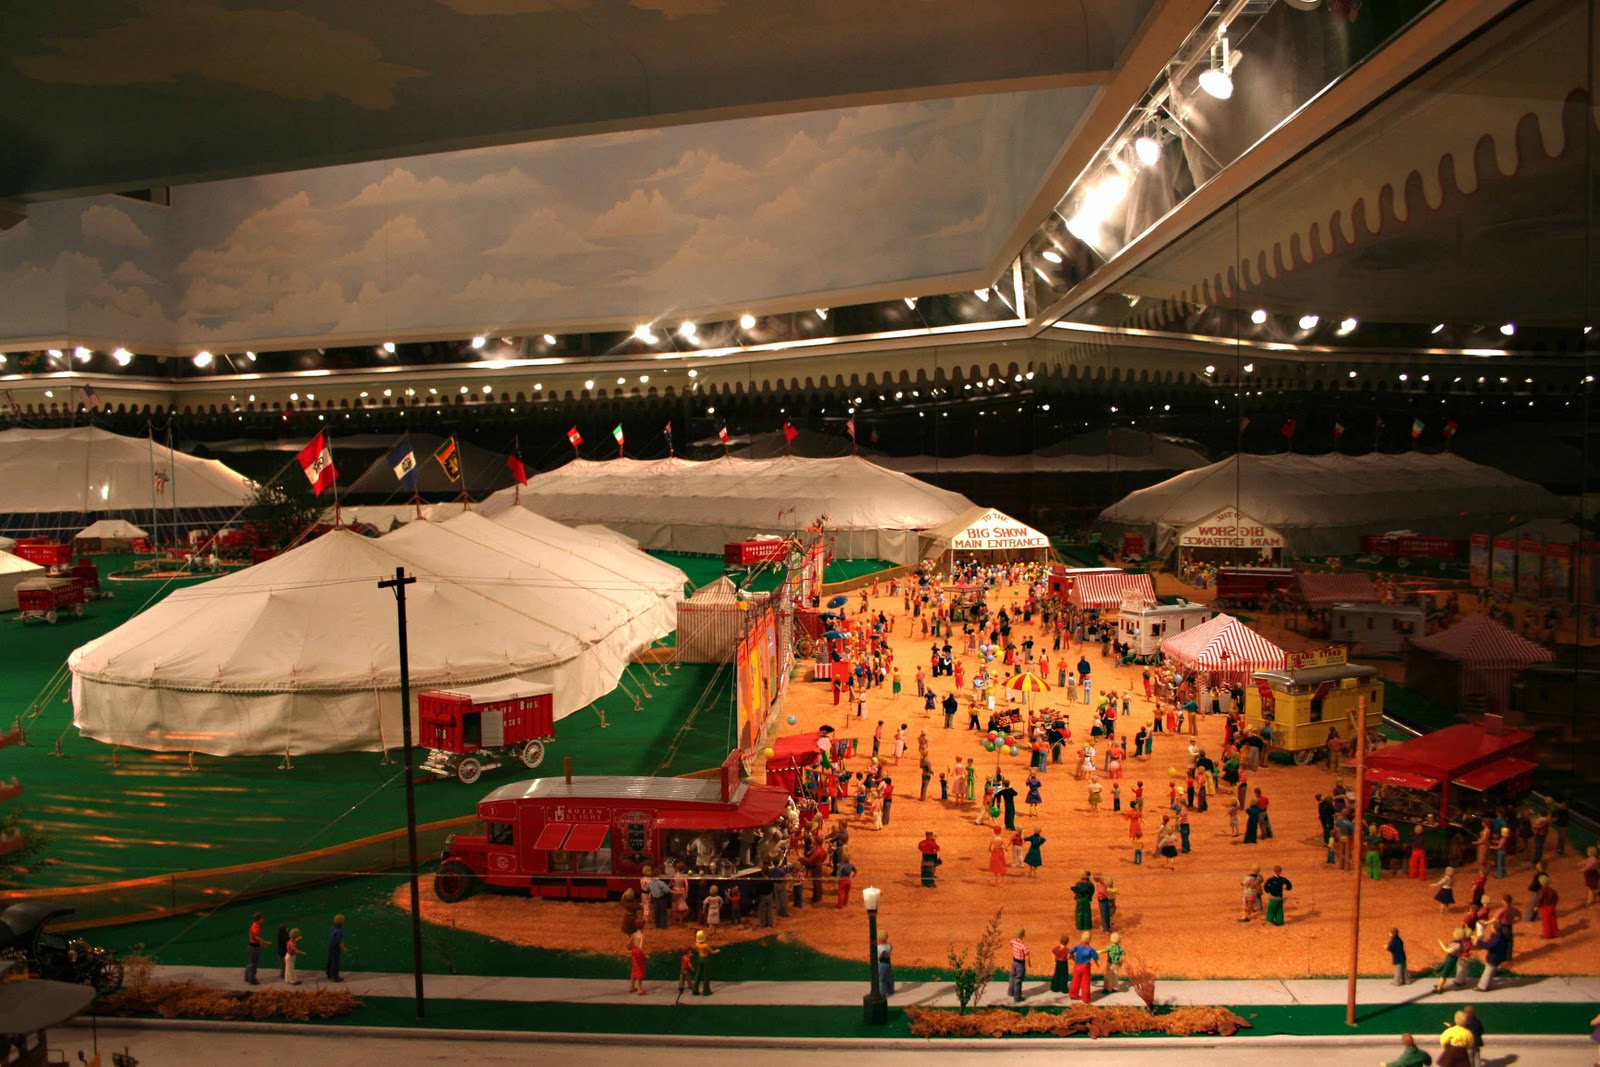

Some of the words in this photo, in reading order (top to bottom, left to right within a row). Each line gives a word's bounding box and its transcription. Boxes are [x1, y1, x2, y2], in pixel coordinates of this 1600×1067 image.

[981, 513, 991, 523] TO
[992, 512, 1009, 523] THE
[966, 528, 990, 538] BIG
[993, 527, 1028, 538] SHOW
[954, 539, 982, 548] MAIN
[987, 537, 1045, 548] ENTRANCE
[1291, 653, 1314, 662] GRAND
[1319, 649, 1341, 658] STAND
[557, 805, 602, 816] FROZEN
[554, 811, 601, 822] DELIGHT
